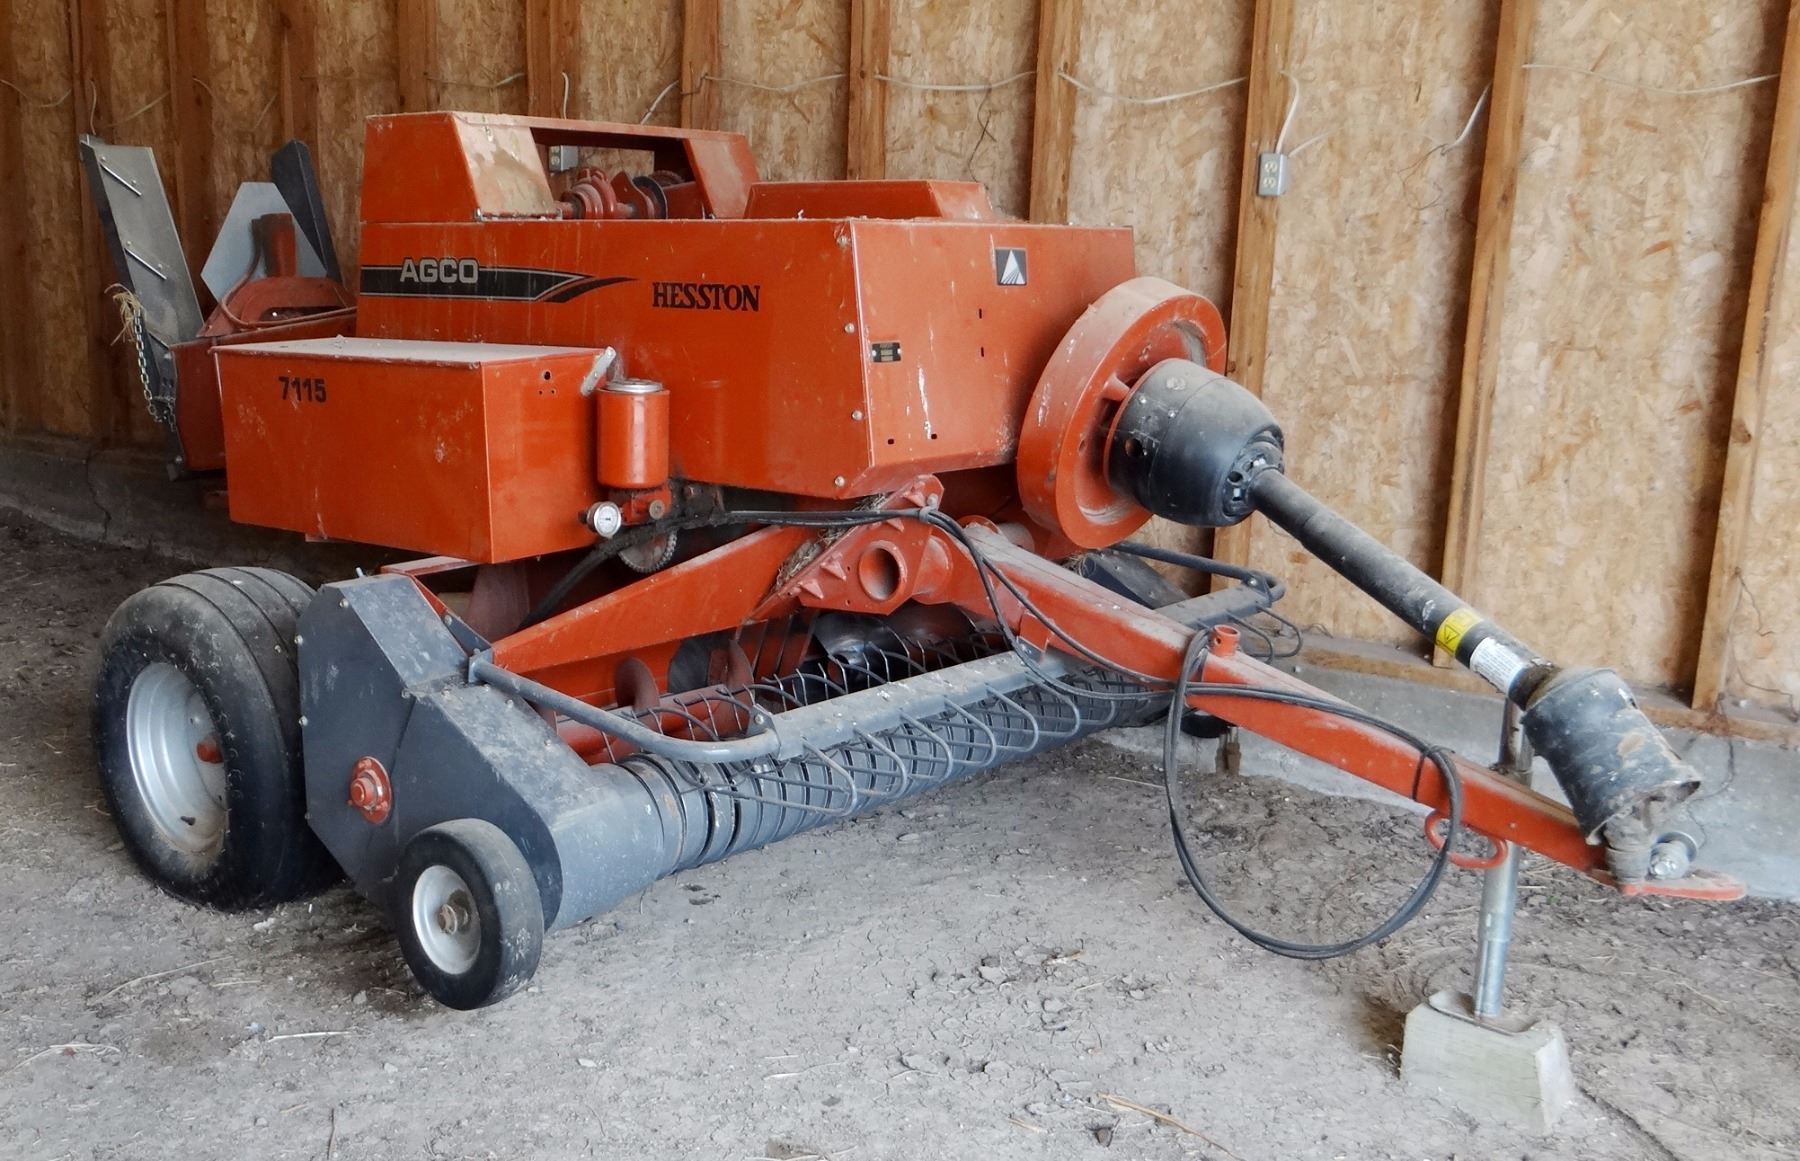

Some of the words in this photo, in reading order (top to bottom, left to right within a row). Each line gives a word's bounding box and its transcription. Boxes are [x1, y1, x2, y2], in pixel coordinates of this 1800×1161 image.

[400, 258, 479, 284] AGCO
[653, 282, 760, 312] HESSTON
[279, 376, 327, 403] 7115
